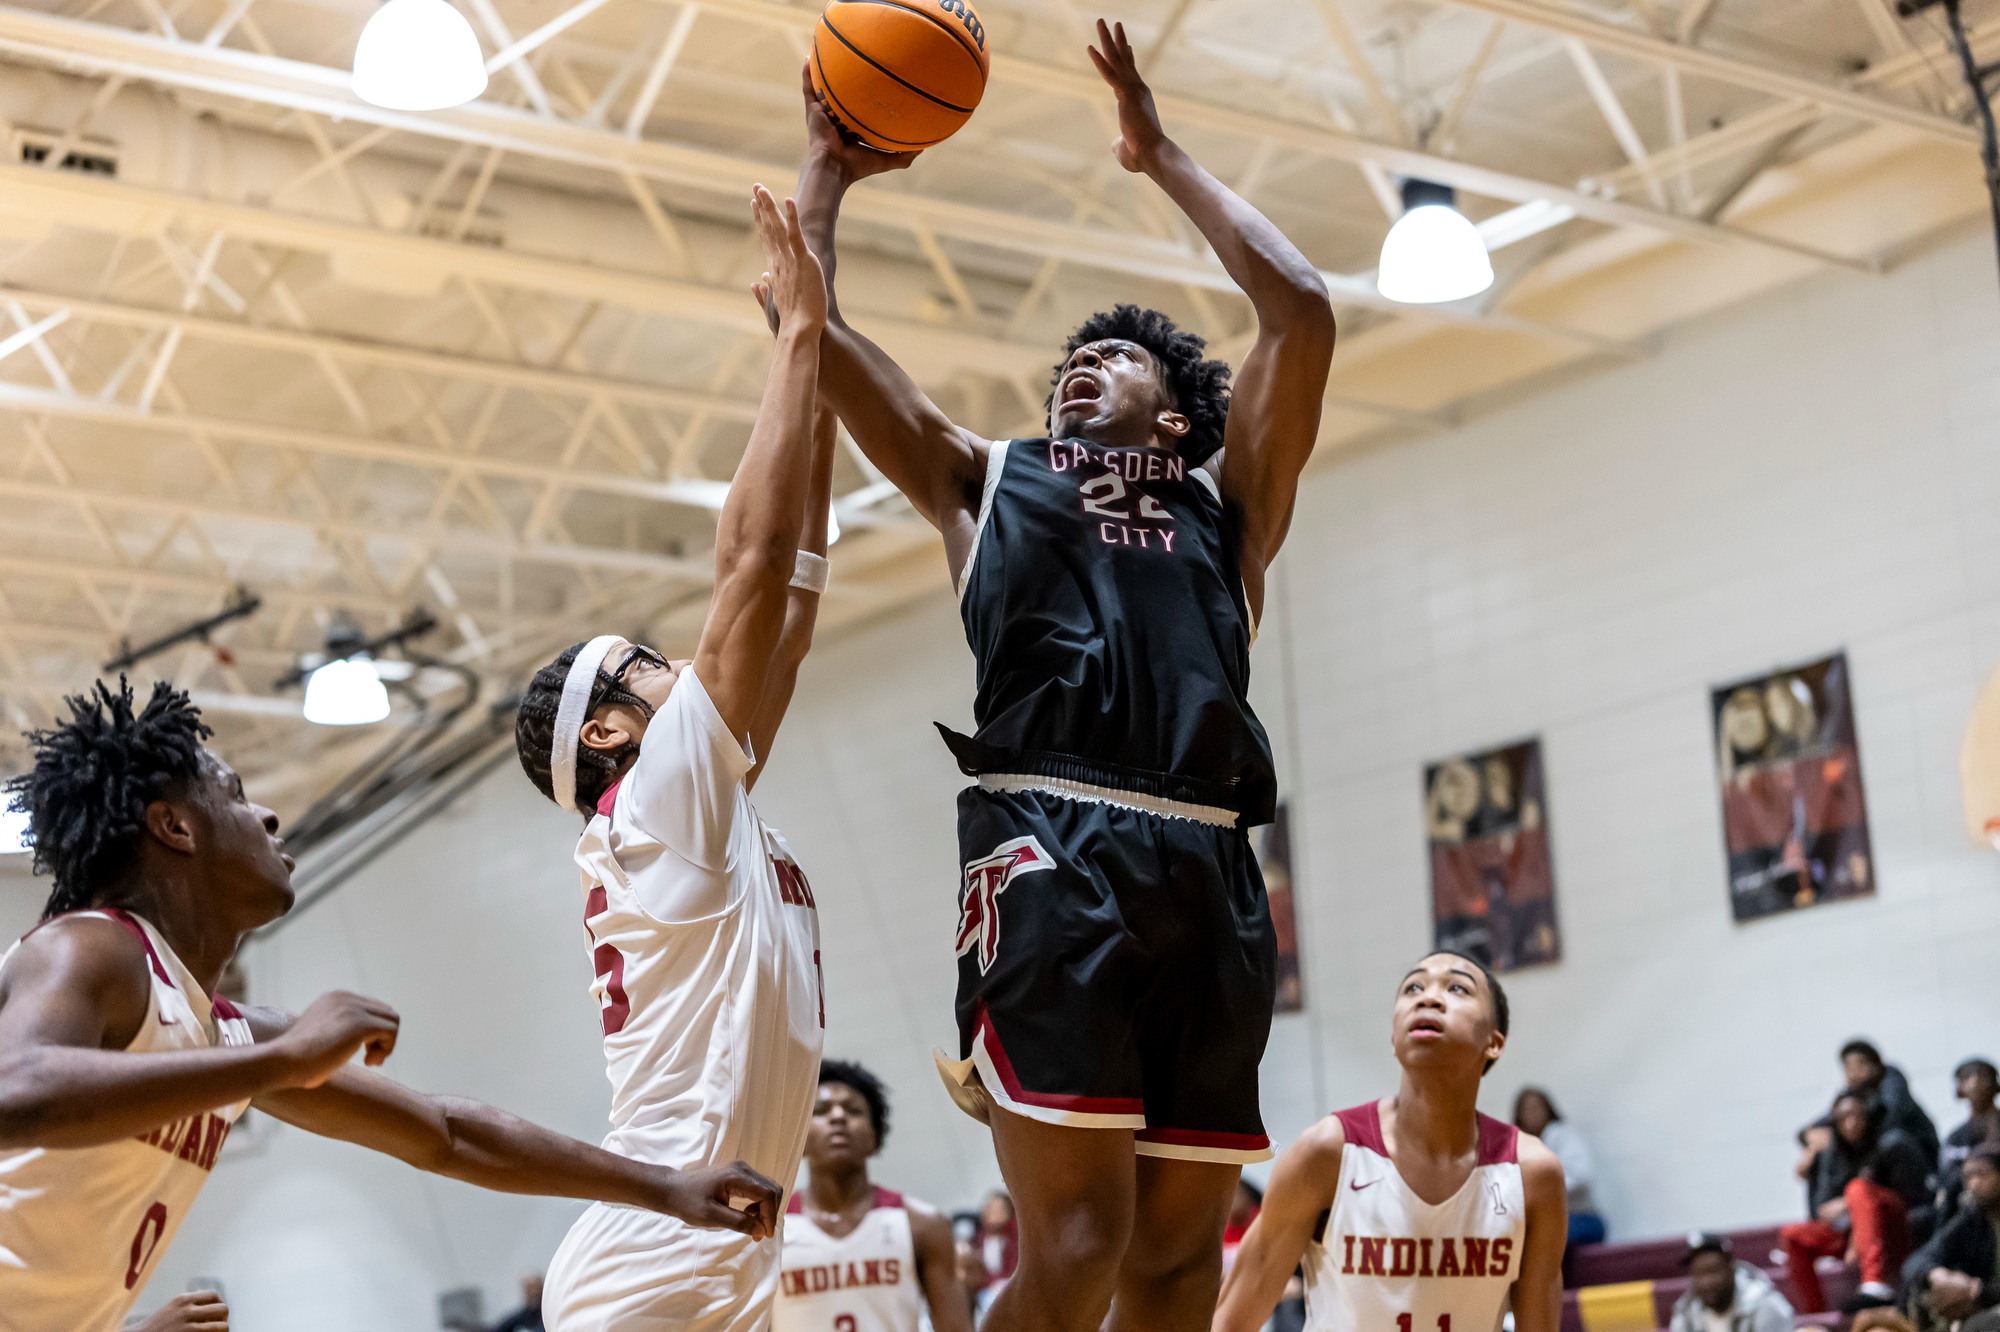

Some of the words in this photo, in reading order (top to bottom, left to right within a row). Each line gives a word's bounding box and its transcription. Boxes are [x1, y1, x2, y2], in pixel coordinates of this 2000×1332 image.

[1049, 440, 1185, 483] GASDEN
[1100, 521, 1176, 553] CITY
[124, 1201, 168, 1291] 0
[1341, 1235, 1513, 1278] INDIANS
[780, 1258, 900, 1298] INDIANS
